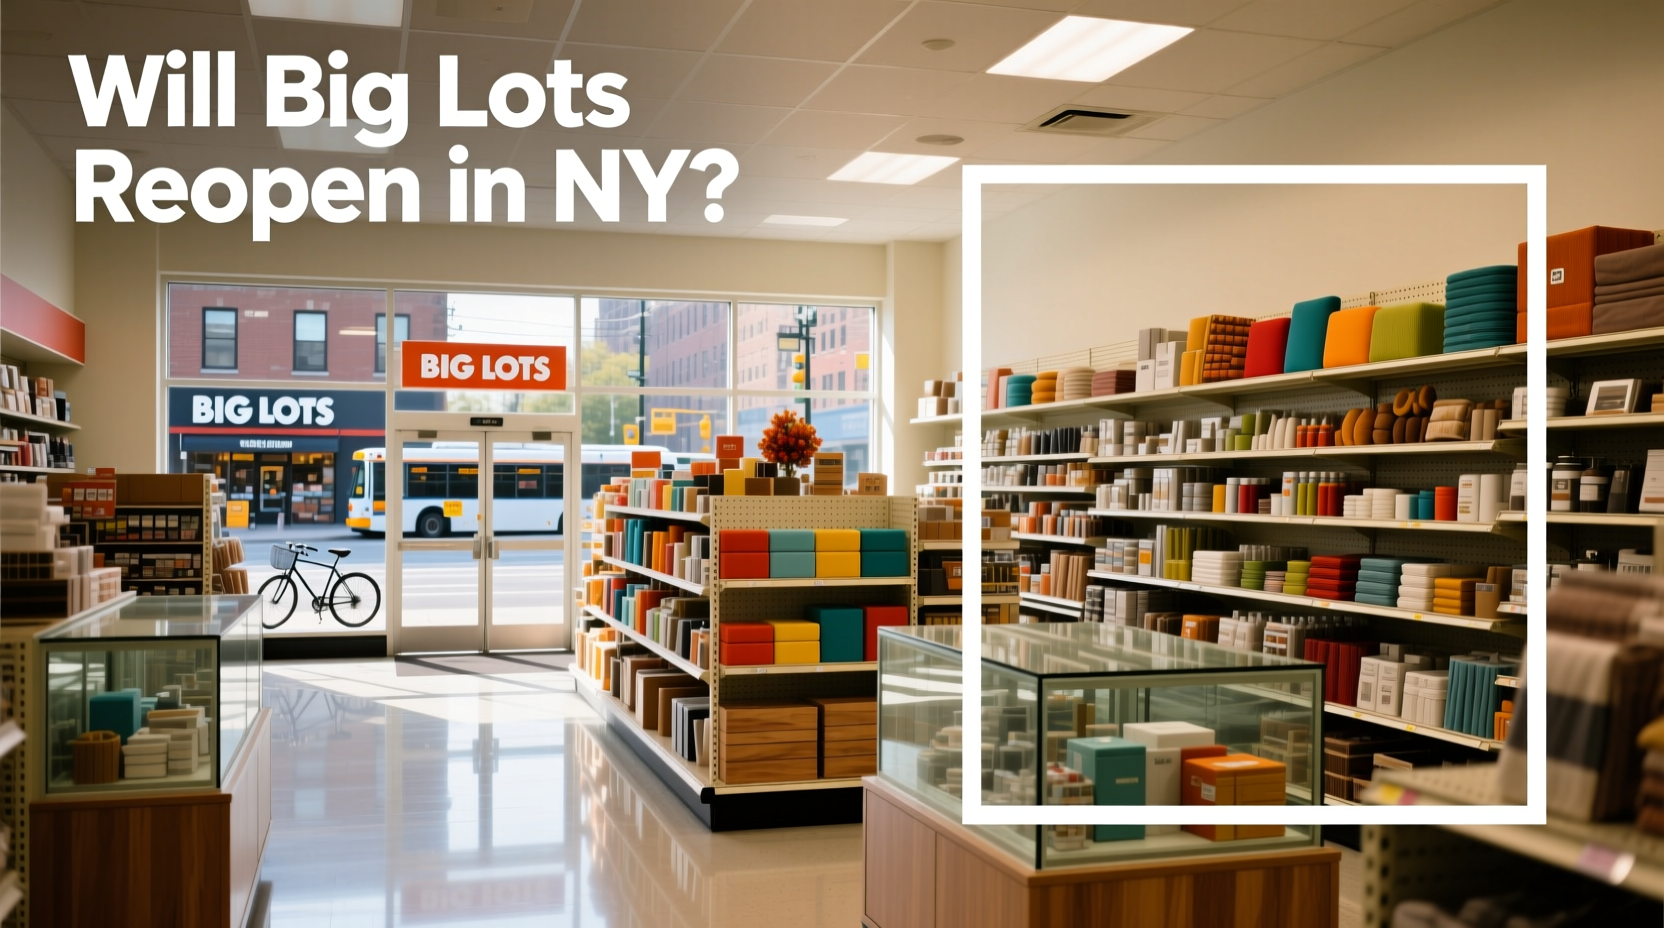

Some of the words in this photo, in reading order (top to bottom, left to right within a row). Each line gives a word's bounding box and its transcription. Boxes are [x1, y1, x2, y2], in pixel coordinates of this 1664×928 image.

[422, 354, 474, 379] BIG
[483, 356, 550, 381] LOTS
[193, 396, 252, 424] BIG
[259, 397, 334, 425] LOTS
